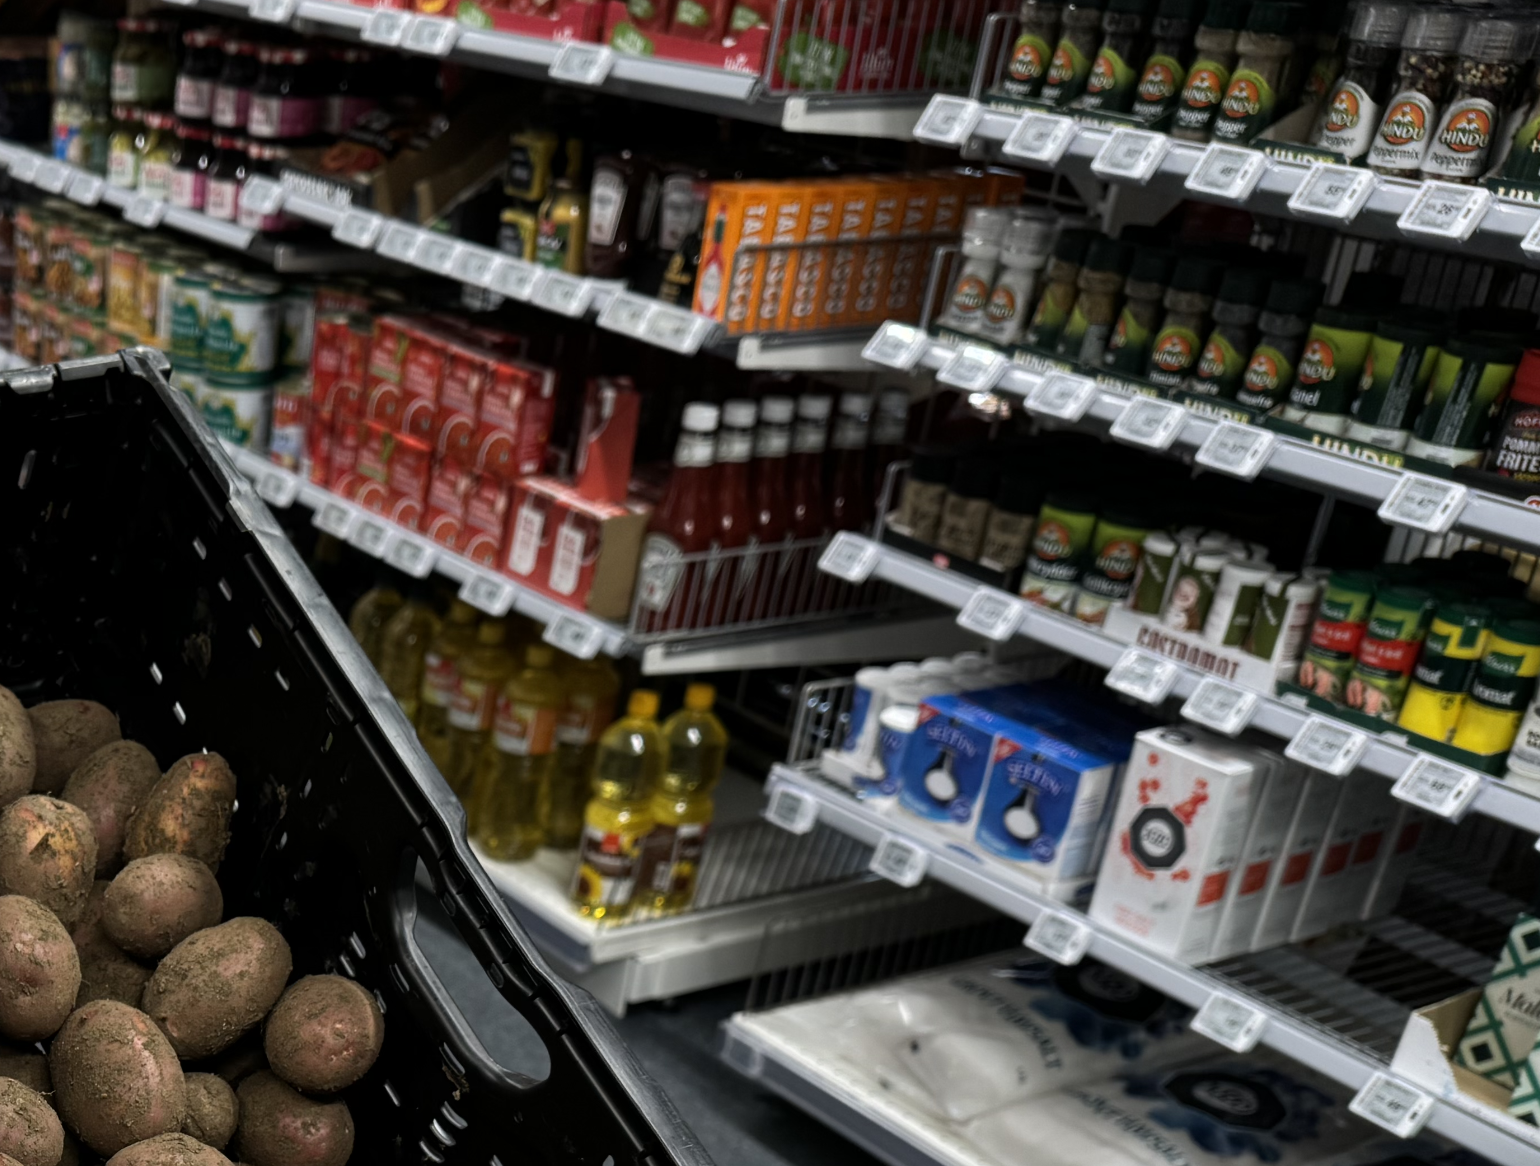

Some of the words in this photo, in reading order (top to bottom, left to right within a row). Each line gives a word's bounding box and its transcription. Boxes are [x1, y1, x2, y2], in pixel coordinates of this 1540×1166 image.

[1382, 123, 1425, 142] HINDU
[1440, 129, 1489, 148] HINDU
[1496, 449, 1540, 473] FRITE
